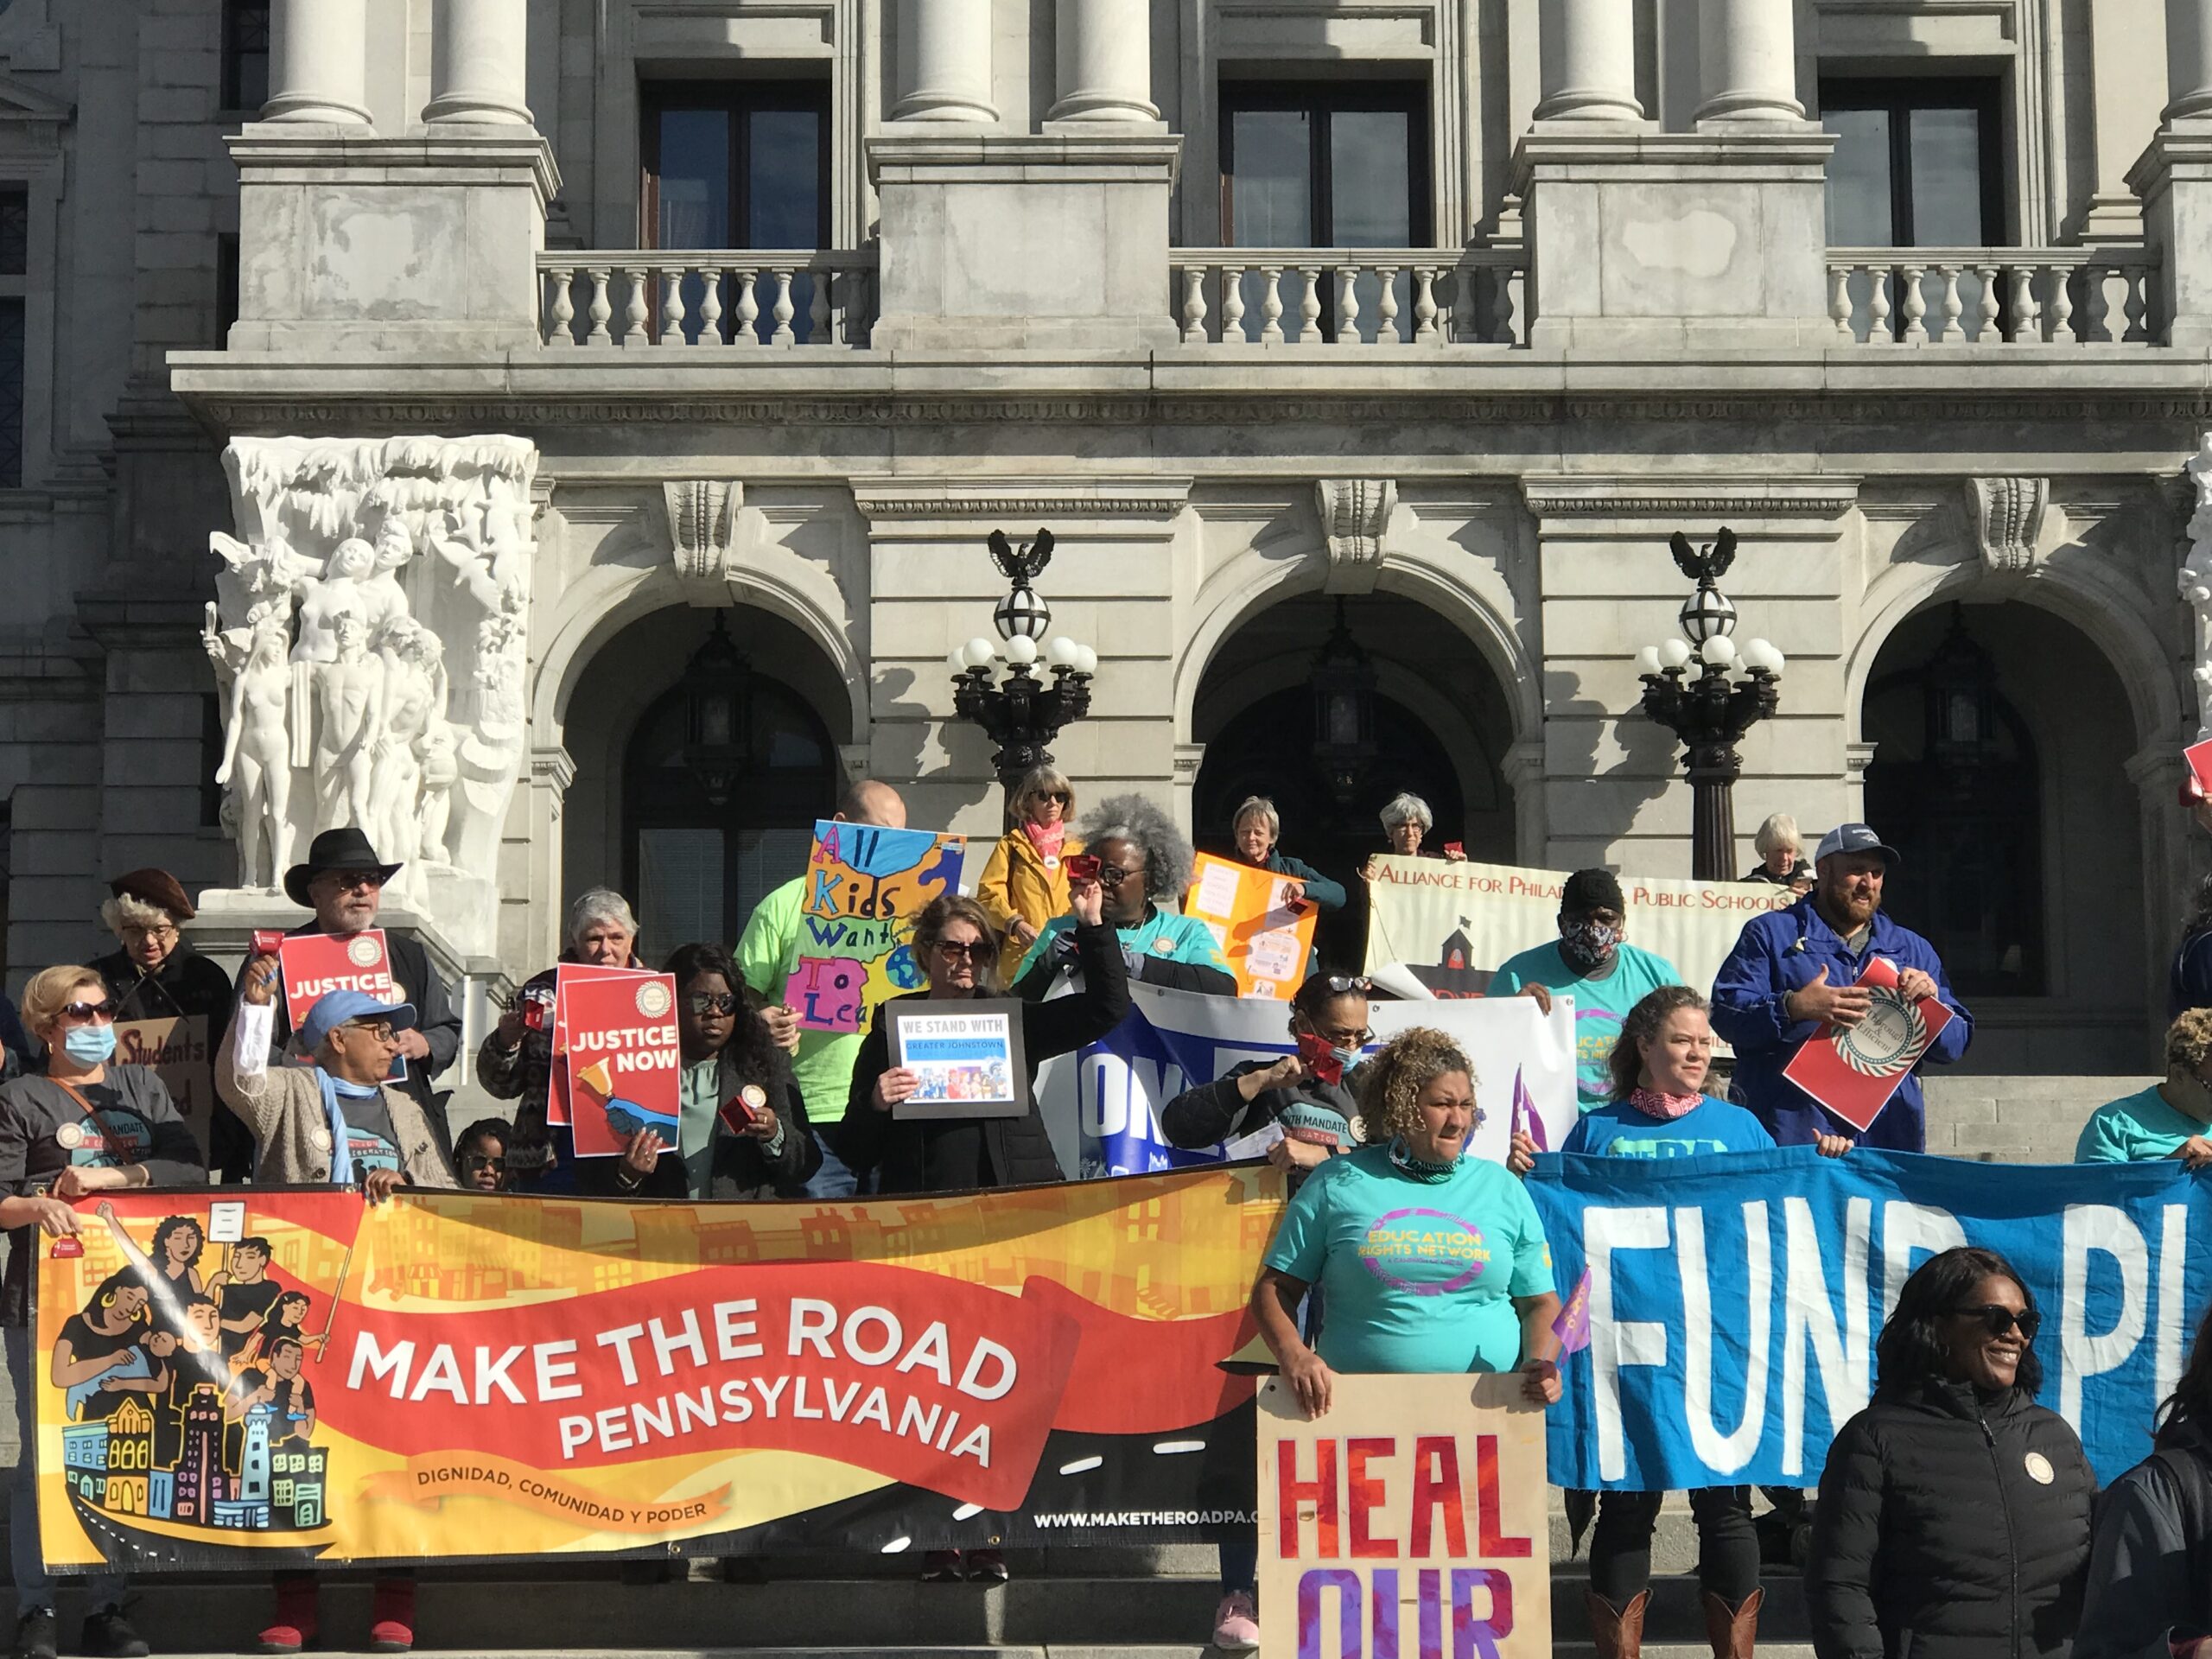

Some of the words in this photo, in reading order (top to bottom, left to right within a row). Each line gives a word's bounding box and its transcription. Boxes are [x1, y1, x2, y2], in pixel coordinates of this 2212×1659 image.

[812, 824, 880, 868] All
[810, 869, 900, 918] Kids
[805, 916, 890, 950] Want
[290, 972, 391, 1000] JUSTICE
[798, 954, 850, 990] To
[804, 993, 879, 1026] Lea
[903, 1021, 923, 1034] WE
[926, 1020, 967, 1033] STAND
[970, 1019, 1003, 1033] WITH
[120, 1028, 206, 1065] Students
[571, 1025, 677, 1052] JUSTICE
[948, 1040, 1004, 1049] JOHNSTOWN
[616, 1049, 678, 1073] NOW
[1302, 1115, 1348, 1135] MANDATE
[1358, 1243, 1412, 1257] RIGHTS
[1417, 1245, 1491, 1262] NETWORK
[1369, 1230, 1482, 1246] EDUCATION
[346, 1331, 584, 1405] MAKE
[596, 1299, 764, 1386] THE
[788, 1298, 1018, 1401] ROAD
[558, 1376, 991, 1468] PENNSYLVANIA
[417, 1467, 513, 1491] DIGNIDAD,
[519, 1479, 625, 1522] COMUNIDAD
[630, 1511, 642, 1524] Y
[646, 1503, 707, 1523] PODER
[1278, 1434, 1532, 1559] HEAL
[1298, 1568, 1514, 1659] OUR
